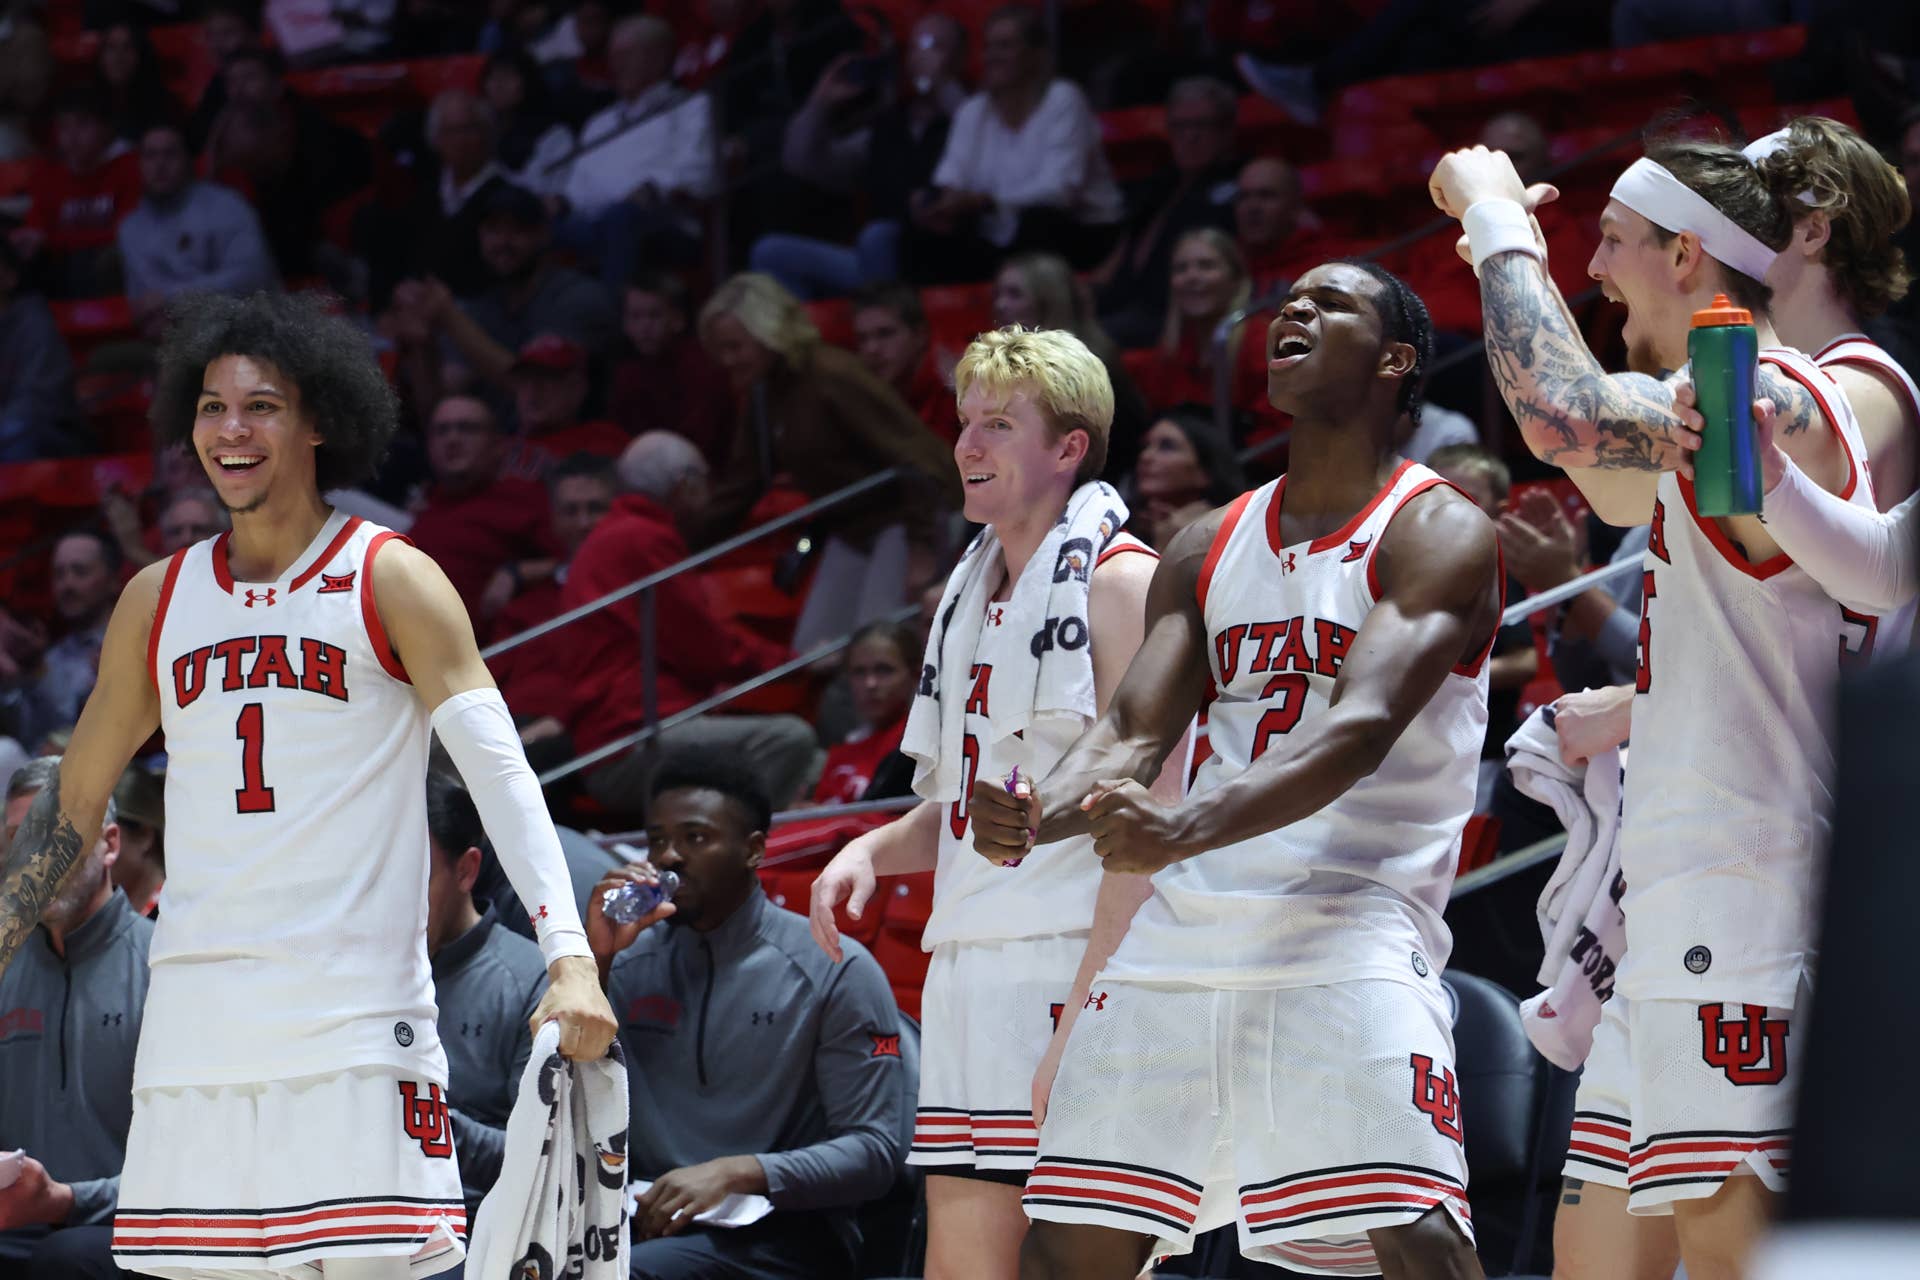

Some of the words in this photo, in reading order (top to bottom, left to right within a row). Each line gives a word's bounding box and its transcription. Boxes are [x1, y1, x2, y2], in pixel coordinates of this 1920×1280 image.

[173, 635, 349, 709] UTAH
[1215, 615, 1358, 688] UTAH
[236, 702, 275, 814] 1
[1251, 672, 1311, 763] 2
